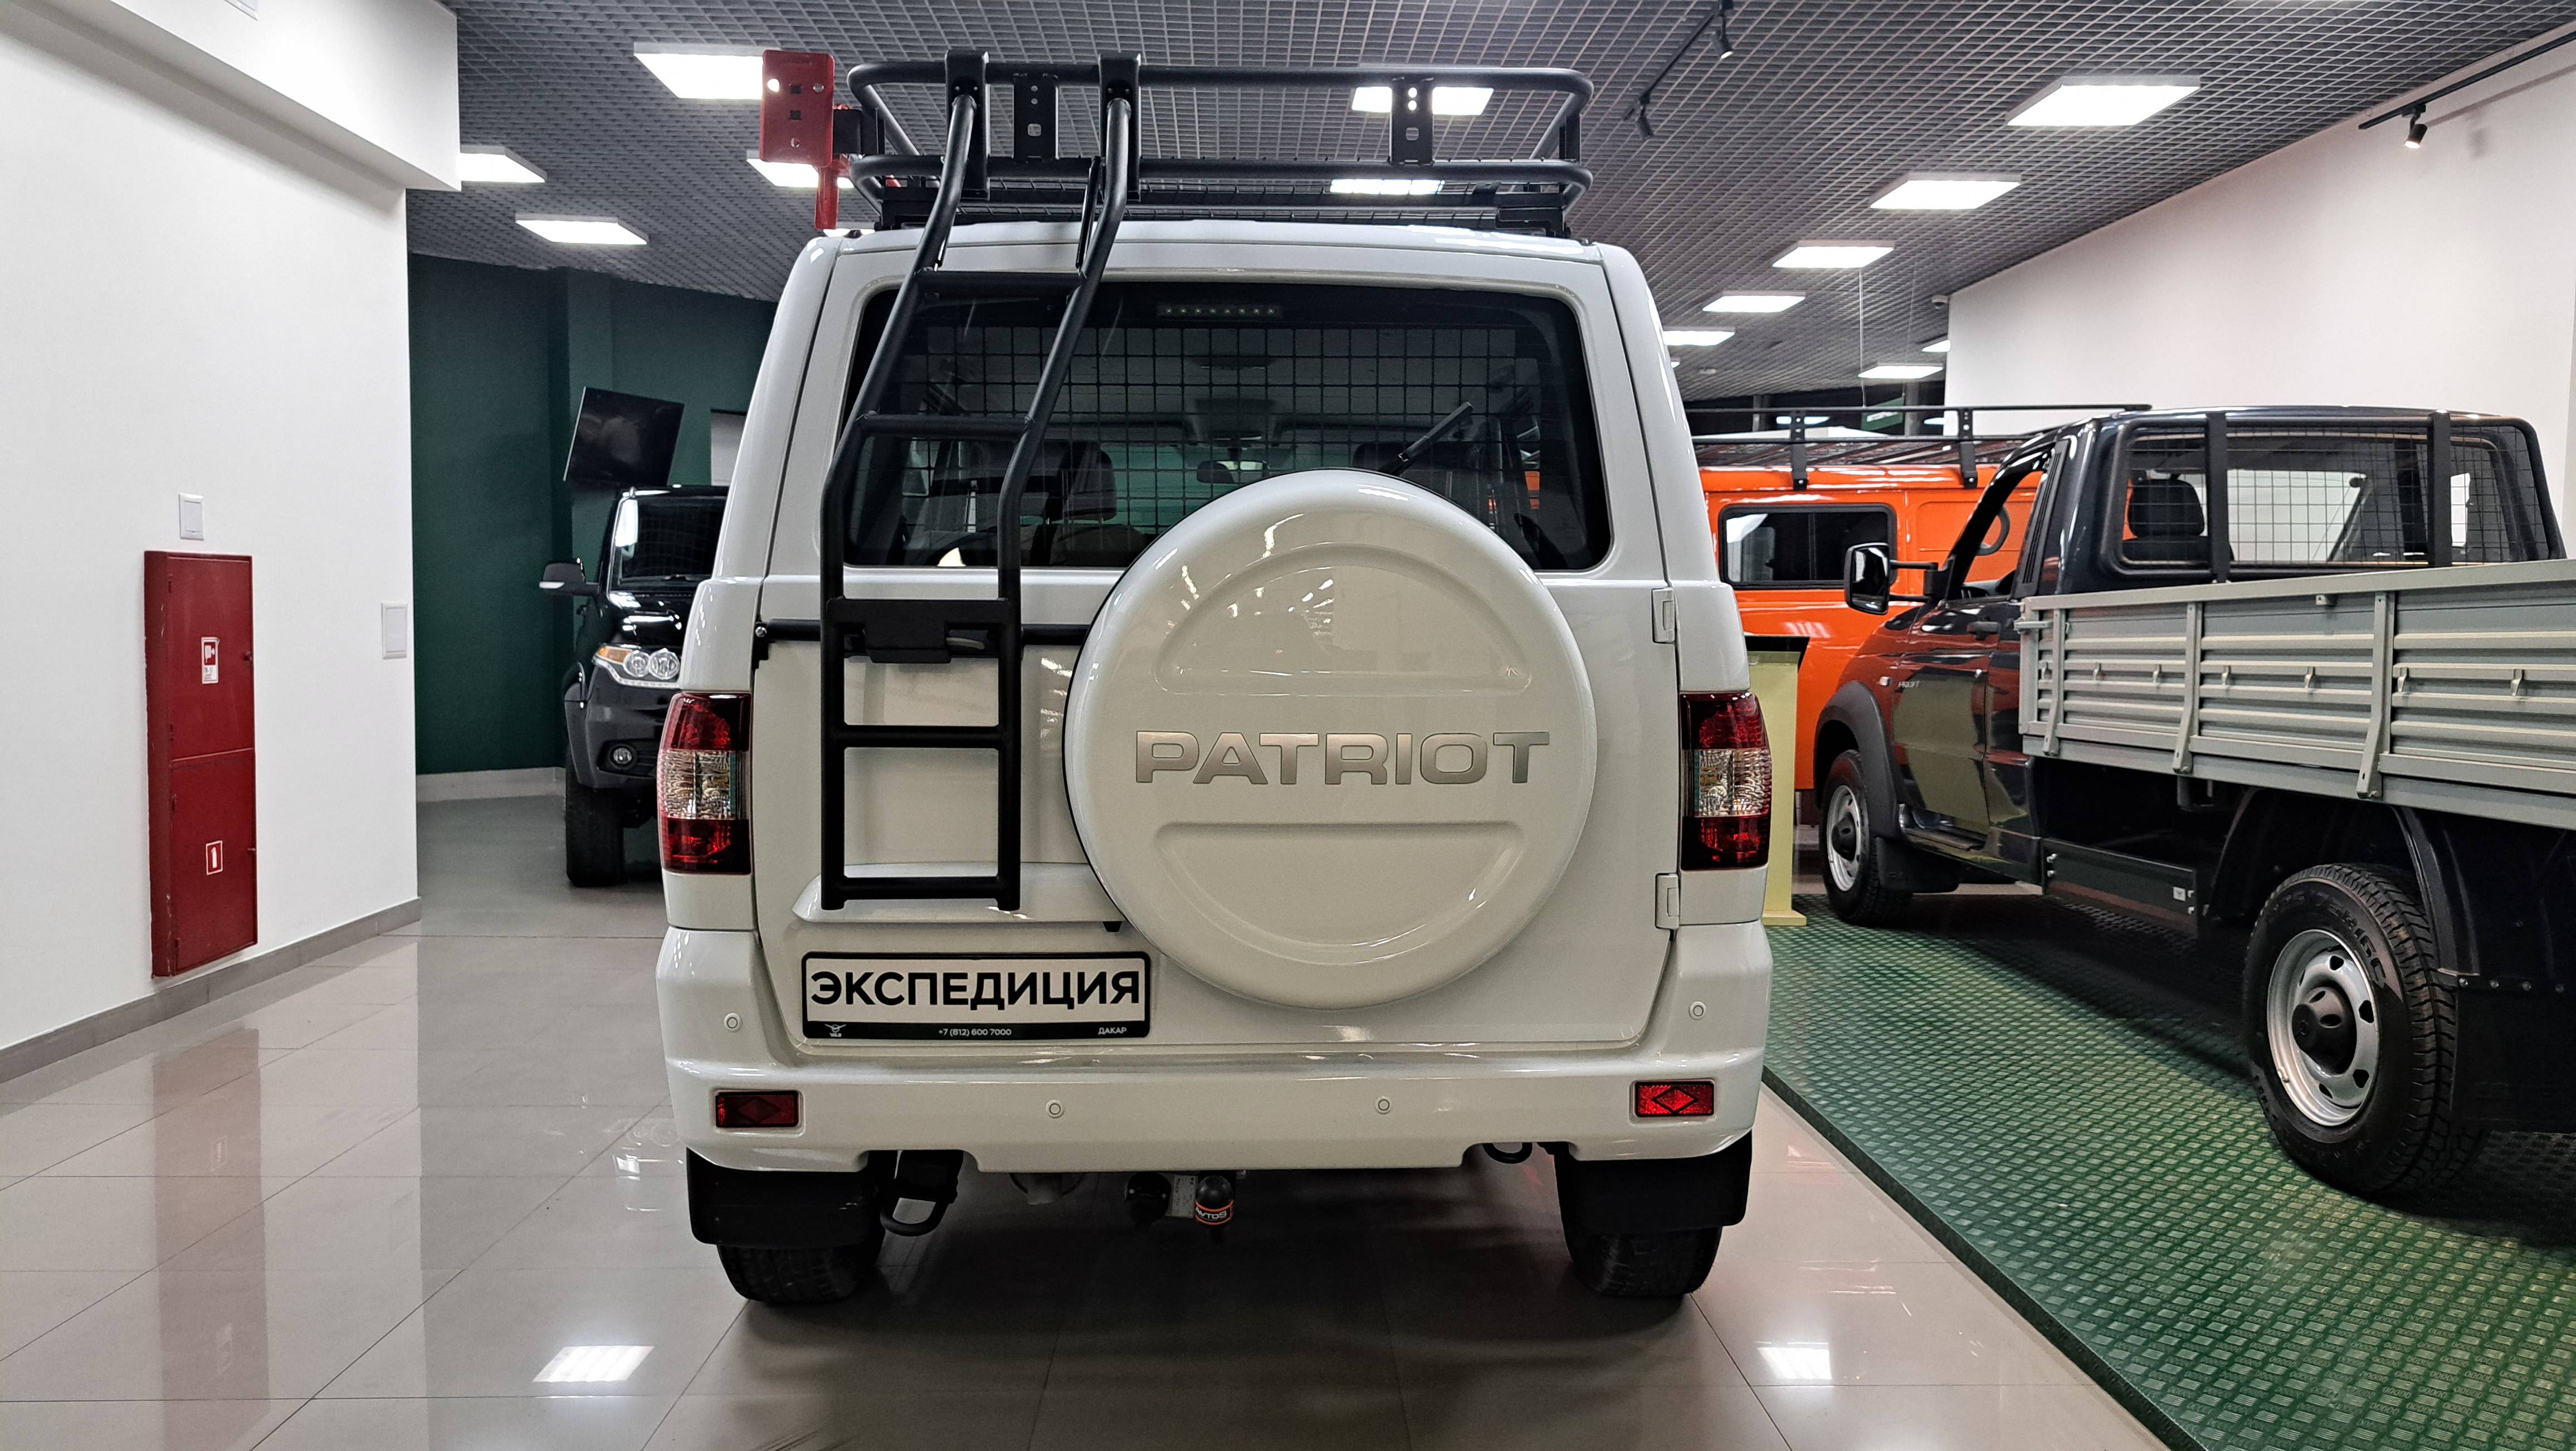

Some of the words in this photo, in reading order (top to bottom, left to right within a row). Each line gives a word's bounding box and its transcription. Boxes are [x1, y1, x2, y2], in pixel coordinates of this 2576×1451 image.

[1136, 731, 1550, 785] PATRIOT
[811, 971, 1140, 1010] ЭКСПЕДИЦИЯ
[949, 1028, 970, 1037] (812)
[1097, 1027, 1128, 1035] ДАКАР
